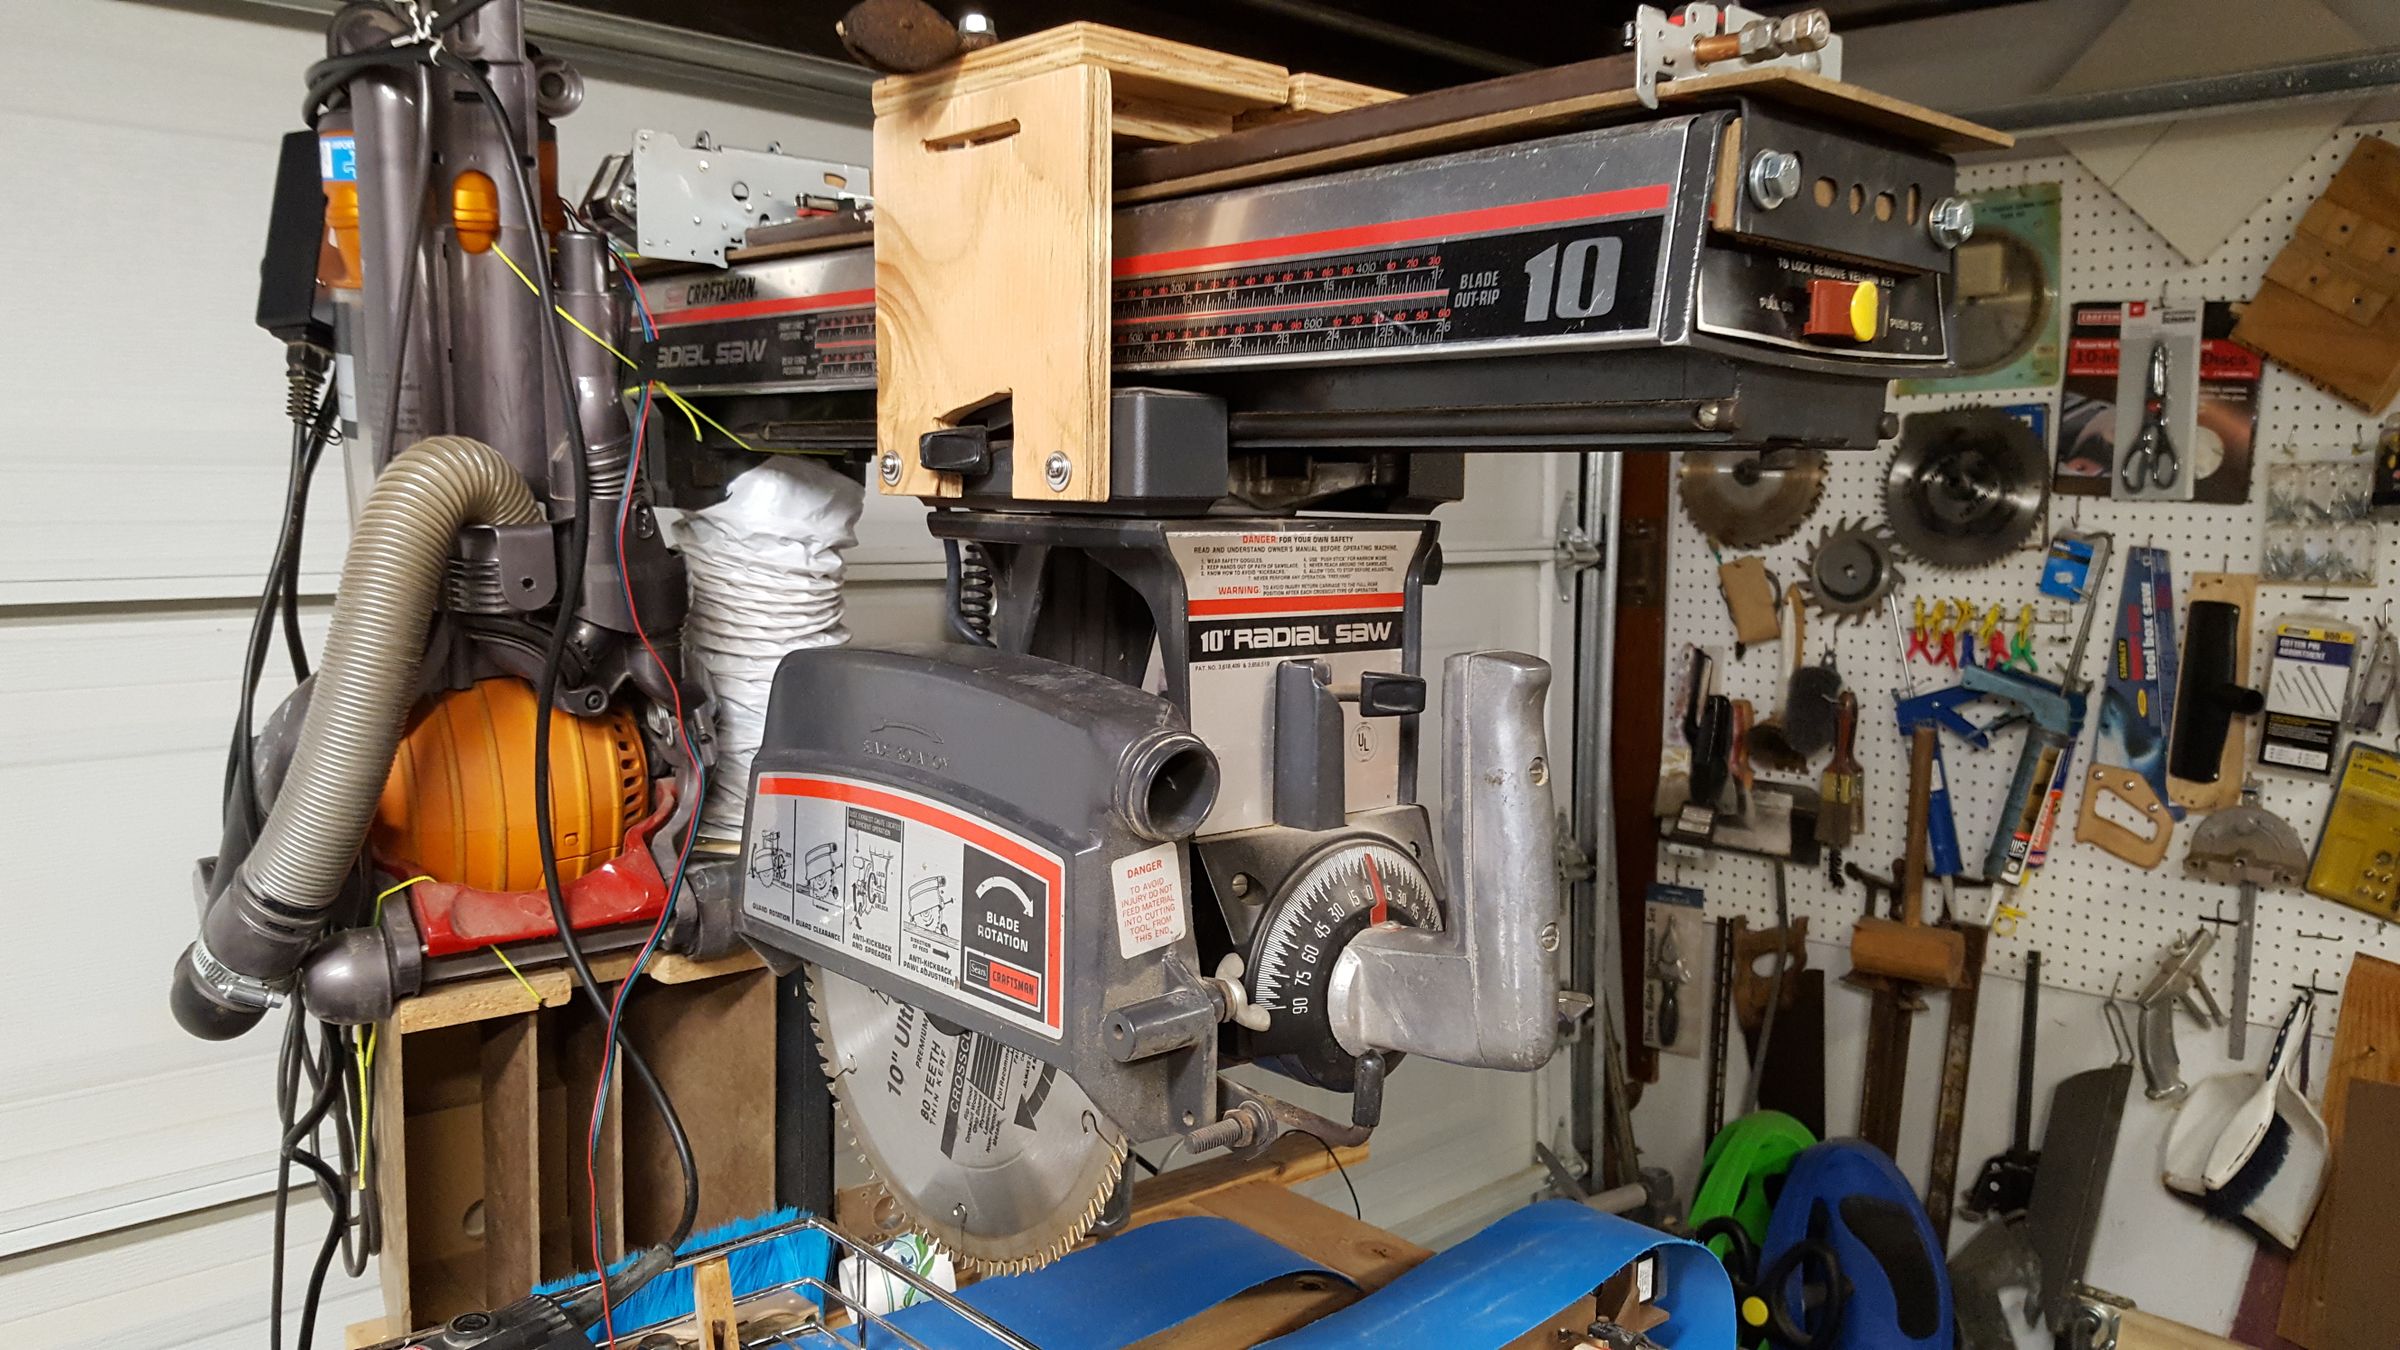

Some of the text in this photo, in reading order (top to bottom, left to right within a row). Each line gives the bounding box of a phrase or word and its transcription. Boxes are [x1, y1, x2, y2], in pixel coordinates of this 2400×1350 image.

[1356, 262, 1377, 274] 400
[1431, 269, 1444, 280] 17
[1813, 265, 1847, 280] REMOVE
[1460, 270, 1500, 289] BLADE
[1524, 236, 1623, 323] 10
[686, 277, 756, 305] CRAFTSMAN
[1454, 289, 1501, 309] OUT-RIP
[1436, 322, 1450, 333] 26
[1889, 318, 1923, 332] PUSH OFF
[657, 339, 768, 369] ADIAL SAW
[1200, 621, 1392, 653] 10" RADIAL SAW
[2141, 581, 2157, 681] tool box saw
[2118, 639, 2128, 679] STANLEY
[1127, 859, 1163, 879] DANGER
[1121, 884, 1173, 908] INJURY DO NOT
[1130, 877, 1164, 895] TO AVOID
[1123, 895, 1175, 918] FEED MATERIAL
[1348, 885, 1373, 908] 15 0
[1397, 890, 1407, 908] 30
[752, 902, 790, 922] GUARD ROTATION
[875, 902, 889, 912] UNLOCK
[1124, 904, 1175, 927] INTO CUTTING
[1328, 902, 1345, 923] 30
[795, 918, 841, 942] GUARD CLEARANCE
[986, 911, 1020, 933] BLADE
[1130, 916, 1172, 935] TOOL FROM
[1313, 921, 1331, 940] 45
[852, 932, 892, 954] ANTI-KICKBACK
[910, 937, 931, 948] DIRECTION
[977, 924, 1028, 953] ROTATION
[1135, 933, 1152, 944] THIS
[852, 941, 891, 962] AND SPREADER
[919, 946, 928, 954] FEED
[1302, 944, 1319, 964] 60
[903, 961, 919, 973] PAWL
[909, 954, 952, 976] ANTI-KICKBACK
[971, 963, 986, 977] Sears
[992, 971, 1033, 995] CRAFTSMAN
[1294, 970, 1311, 987] 75
[1292, 997, 1309, 1015] 90
[915, 1018, 929, 1070] PREMIUM
[887, 1050, 905, 1096] 10"
[921, 1040, 940, 1120] 80 TEETH
[1022, 1060, 1031, 1089] ALWAYS
[929, 1049, 946, 1126] THIN KERF
[996, 1087, 1004, 1103] Not
